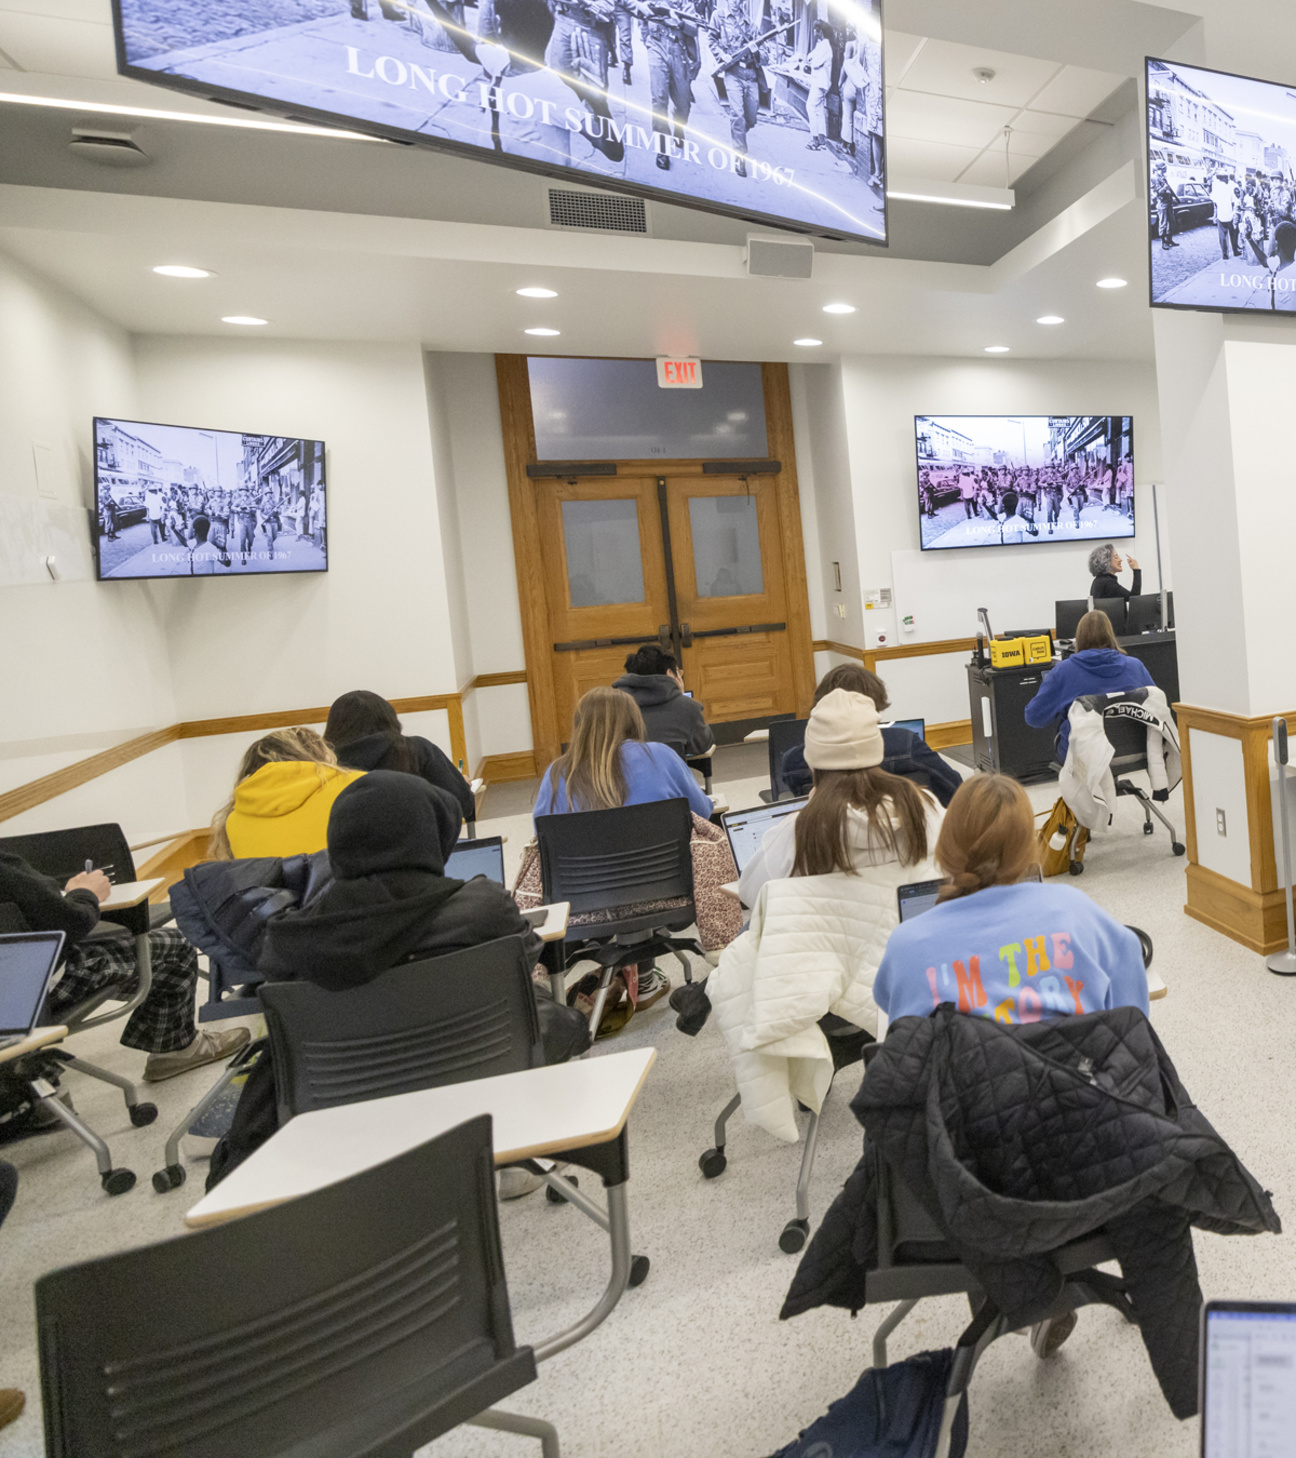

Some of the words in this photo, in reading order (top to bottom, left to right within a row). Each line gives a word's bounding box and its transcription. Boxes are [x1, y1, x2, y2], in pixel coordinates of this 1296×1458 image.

[345, 45, 468, 102] LONG
[479, 81, 557, 126] HOT
[565, 106, 702, 165] SUMMER
[707, 147, 746, 174] OF
[751, 159, 796, 188] 1967
[1220, 273, 1263, 289] LONG
[664, 361, 696, 384] EXIT
[966, 526, 993, 535] LONG
[997, 525, 1020, 533] HOT
[1021, 522, 1064, 532] SUMMER
[1081, 520, 1097, 528] 1967
[152, 552, 184, 563] LONG
[187, 552, 212, 562] HOT
[213, 551, 257, 561] SUMMER
[259, 551, 272, 560] OF
[274, 550, 291, 559] 1967
[1001, 650, 1021, 658] IOWA
[926, 955, 988, 1013] I'M
[999, 932, 1074, 988] THE
[983, 975, 1084, 1025] TORY
